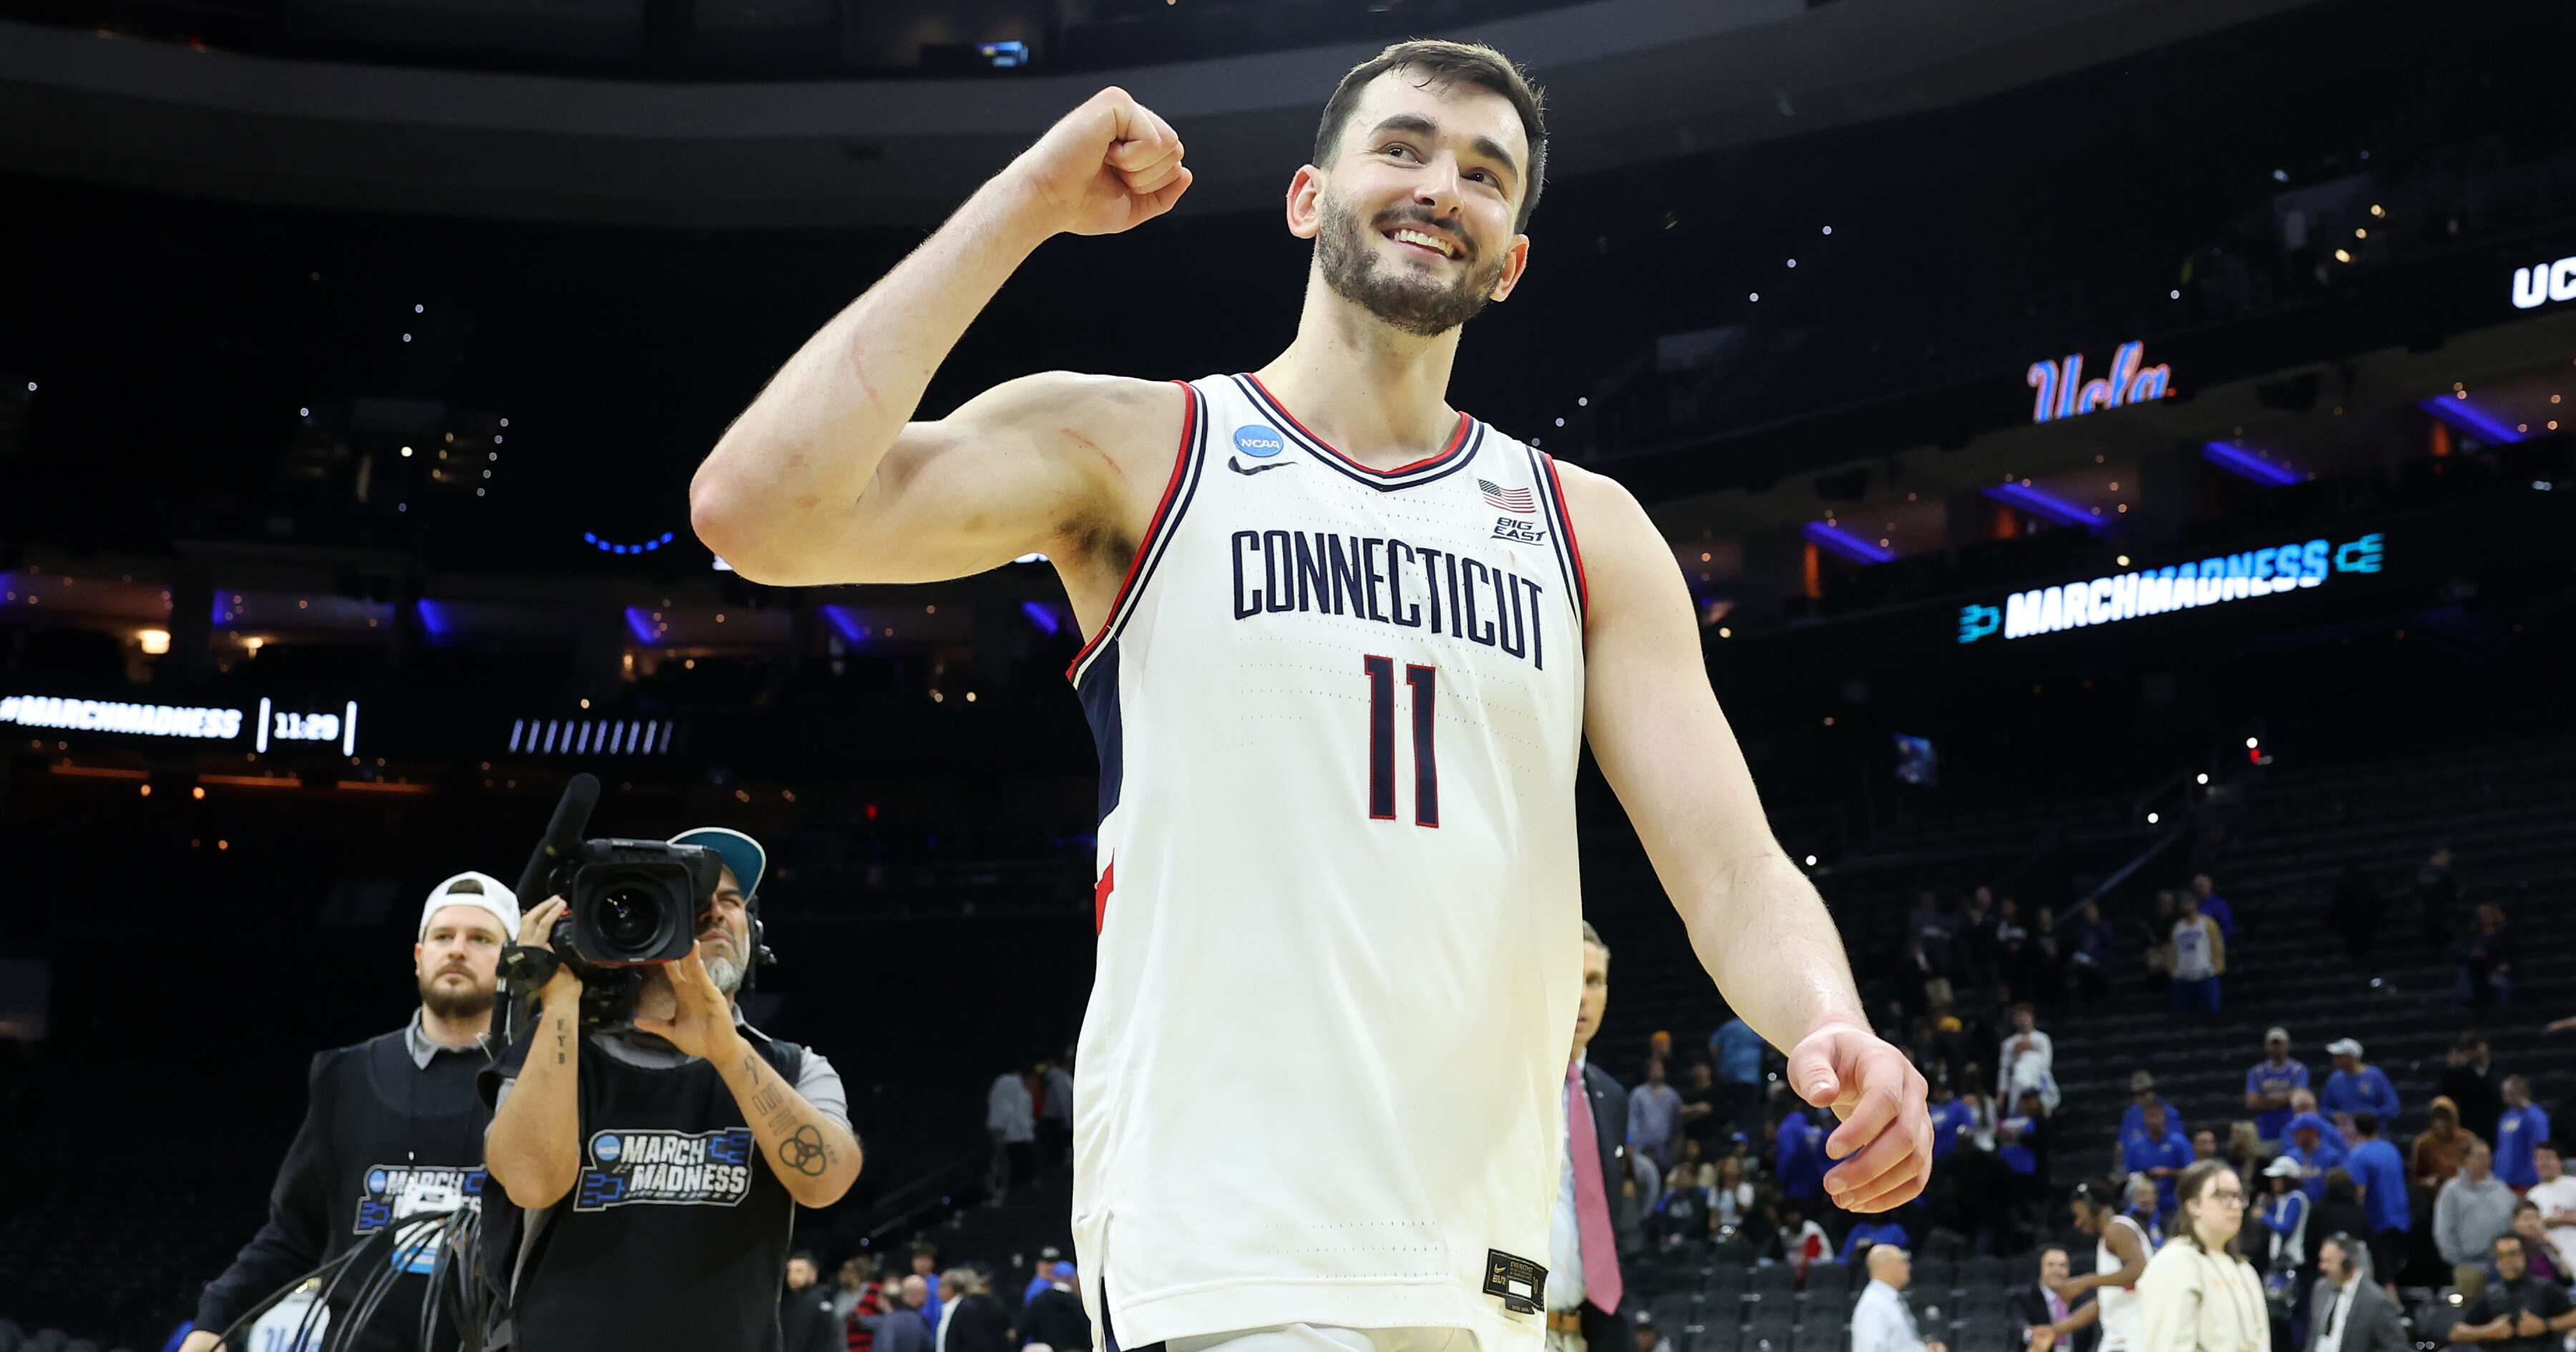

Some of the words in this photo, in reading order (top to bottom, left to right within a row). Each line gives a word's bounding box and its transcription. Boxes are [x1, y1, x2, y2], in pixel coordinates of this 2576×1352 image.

[1240, 438, 1280, 449] NCAA
[1493, 525, 1546, 542] EAST
[1496, 516, 1535, 530] BIG
[1231, 529, 1543, 671] CONNECTICUT
[0, 695, 243, 739] #MARCHMADNESS
[1363, 653, 1439, 828] 11
[620, 1135, 707, 1165] MARCH
[629, 1163, 748, 1193] MADNESS
